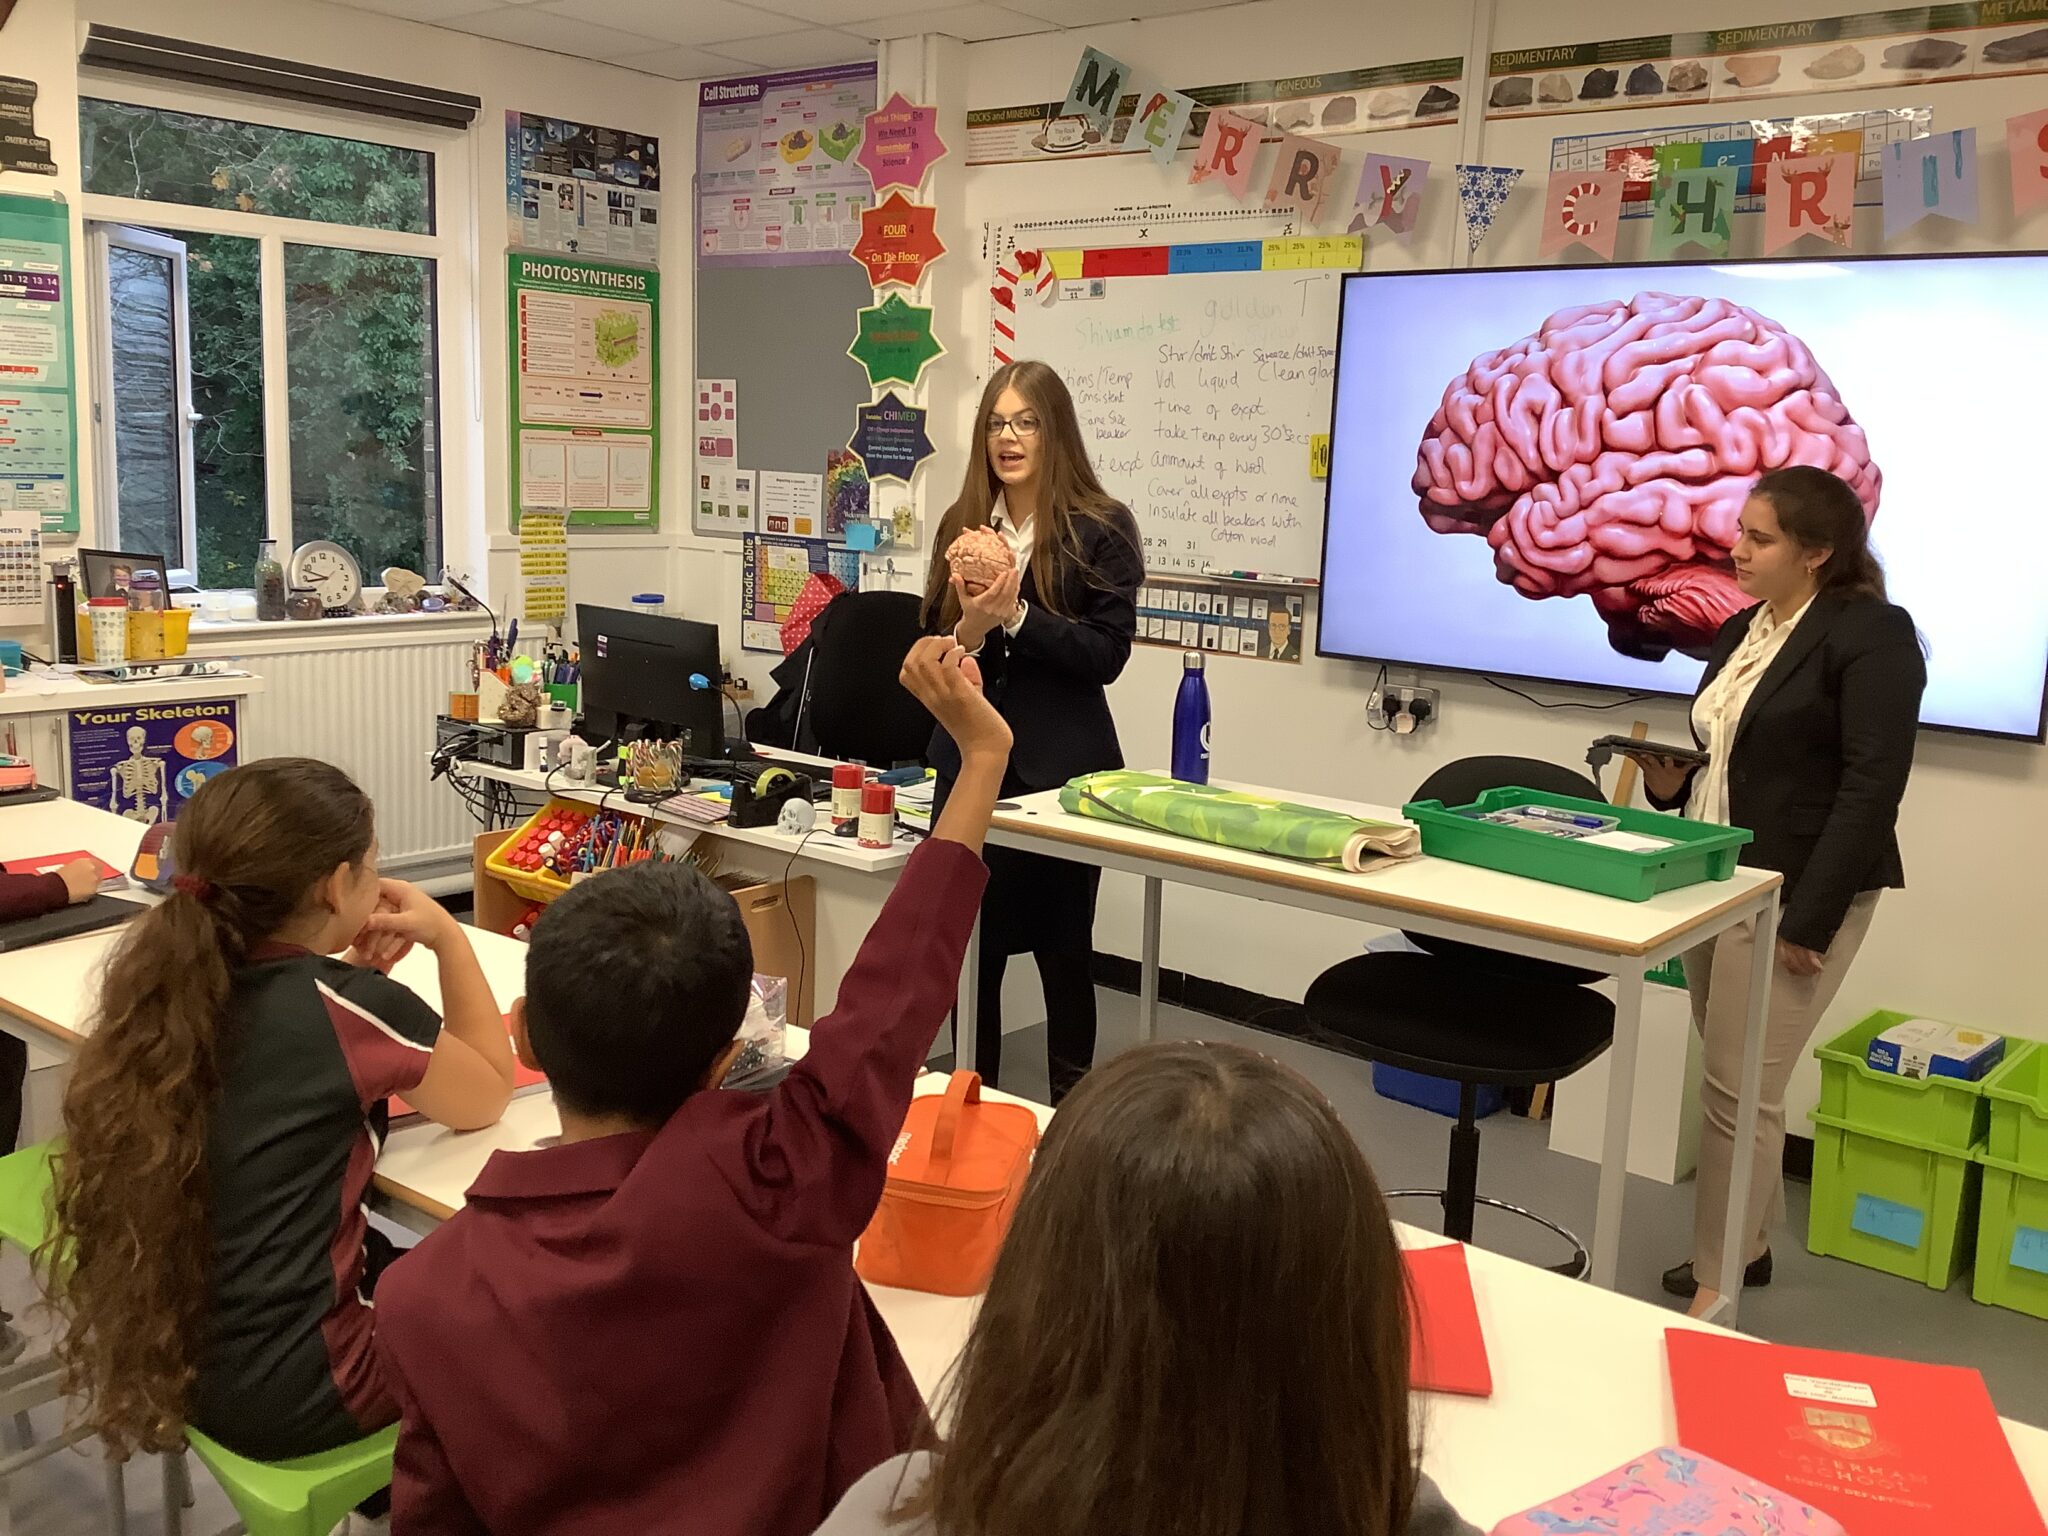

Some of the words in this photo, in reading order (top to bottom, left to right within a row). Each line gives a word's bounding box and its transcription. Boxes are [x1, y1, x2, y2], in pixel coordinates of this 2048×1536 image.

[1717, 22, 1817, 46] SEDIMENTARY
[1492, 47, 1577, 67] SEDIMENTARY
[1276, 76, 1322, 91] IGNEOUS
[704, 86, 719, 101] Cell
[719, 83, 759, 100] Structures
[2, 104, 30, 113] MANTLE
[968, 111, 990, 123] ROCKS
[991, 110, 1005, 120] and
[1006, 107, 1041, 119] MINERALS
[890, 113, 911, 123] Things
[912, 111, 924, 120] Do
[879, 130, 888, 139] We
[889, 128, 906, 136] Need
[908, 127, 917, 135] To
[5, 136, 28, 146] OUTER
[29, 139, 47, 147] CORE
[912, 142, 919, 150] In
[16, 160, 38, 169] INNER
[39, 164, 57, 172] CORE
[507, 137, 518, 186] Science
[883, 224, 907, 236] FOUR
[1268, 243, 1281, 252] 25%
[1292, 241, 1305, 251] 25%
[1318, 240, 1331, 250] 25%
[1343, 240, 1357, 249] 25%
[872, 253, 882, 262] On
[884, 252, 897, 261] The
[898, 251, 920, 261] Floor
[3, 274, 13, 282] 11
[18, 275, 29, 284] 12
[32, 276, 43, 285] 13
[47, 278, 58, 286] 14
[521, 261, 647, 290] PHOTOSYNTHESIS
[1024, 288, 1033, 297] 30
[1155, 369, 1176, 390] Vol
[883, 410, 917, 422] CHIMED
[1095, 427, 1133, 440] beaker
[1229, 431, 1259, 452] every
[1255, 493, 1266, 503] or
[1271, 492, 1299, 508] none
[1202, 507, 1220, 526] all
[1222, 509, 1266, 529] beakers
[1143, 537, 1153, 546] 28
[1157, 538, 1167, 548] 29
[1186, 540, 1196, 550] 31
[319, 552, 326, 560] 12
[744, 537, 754, 567] Table
[1158, 556, 1166, 566] 13
[1172, 557, 1181, 567] 14
[1187, 559, 1196, 568] 15
[743, 571, 754, 616] Periodic
[75, 712, 132, 725] Your
[135, 705, 230, 722] Skeleton
[1777, 1450, 1929, 1485] CATERHAM
[1801, 1463, 1911, 1493] SCHOOL
